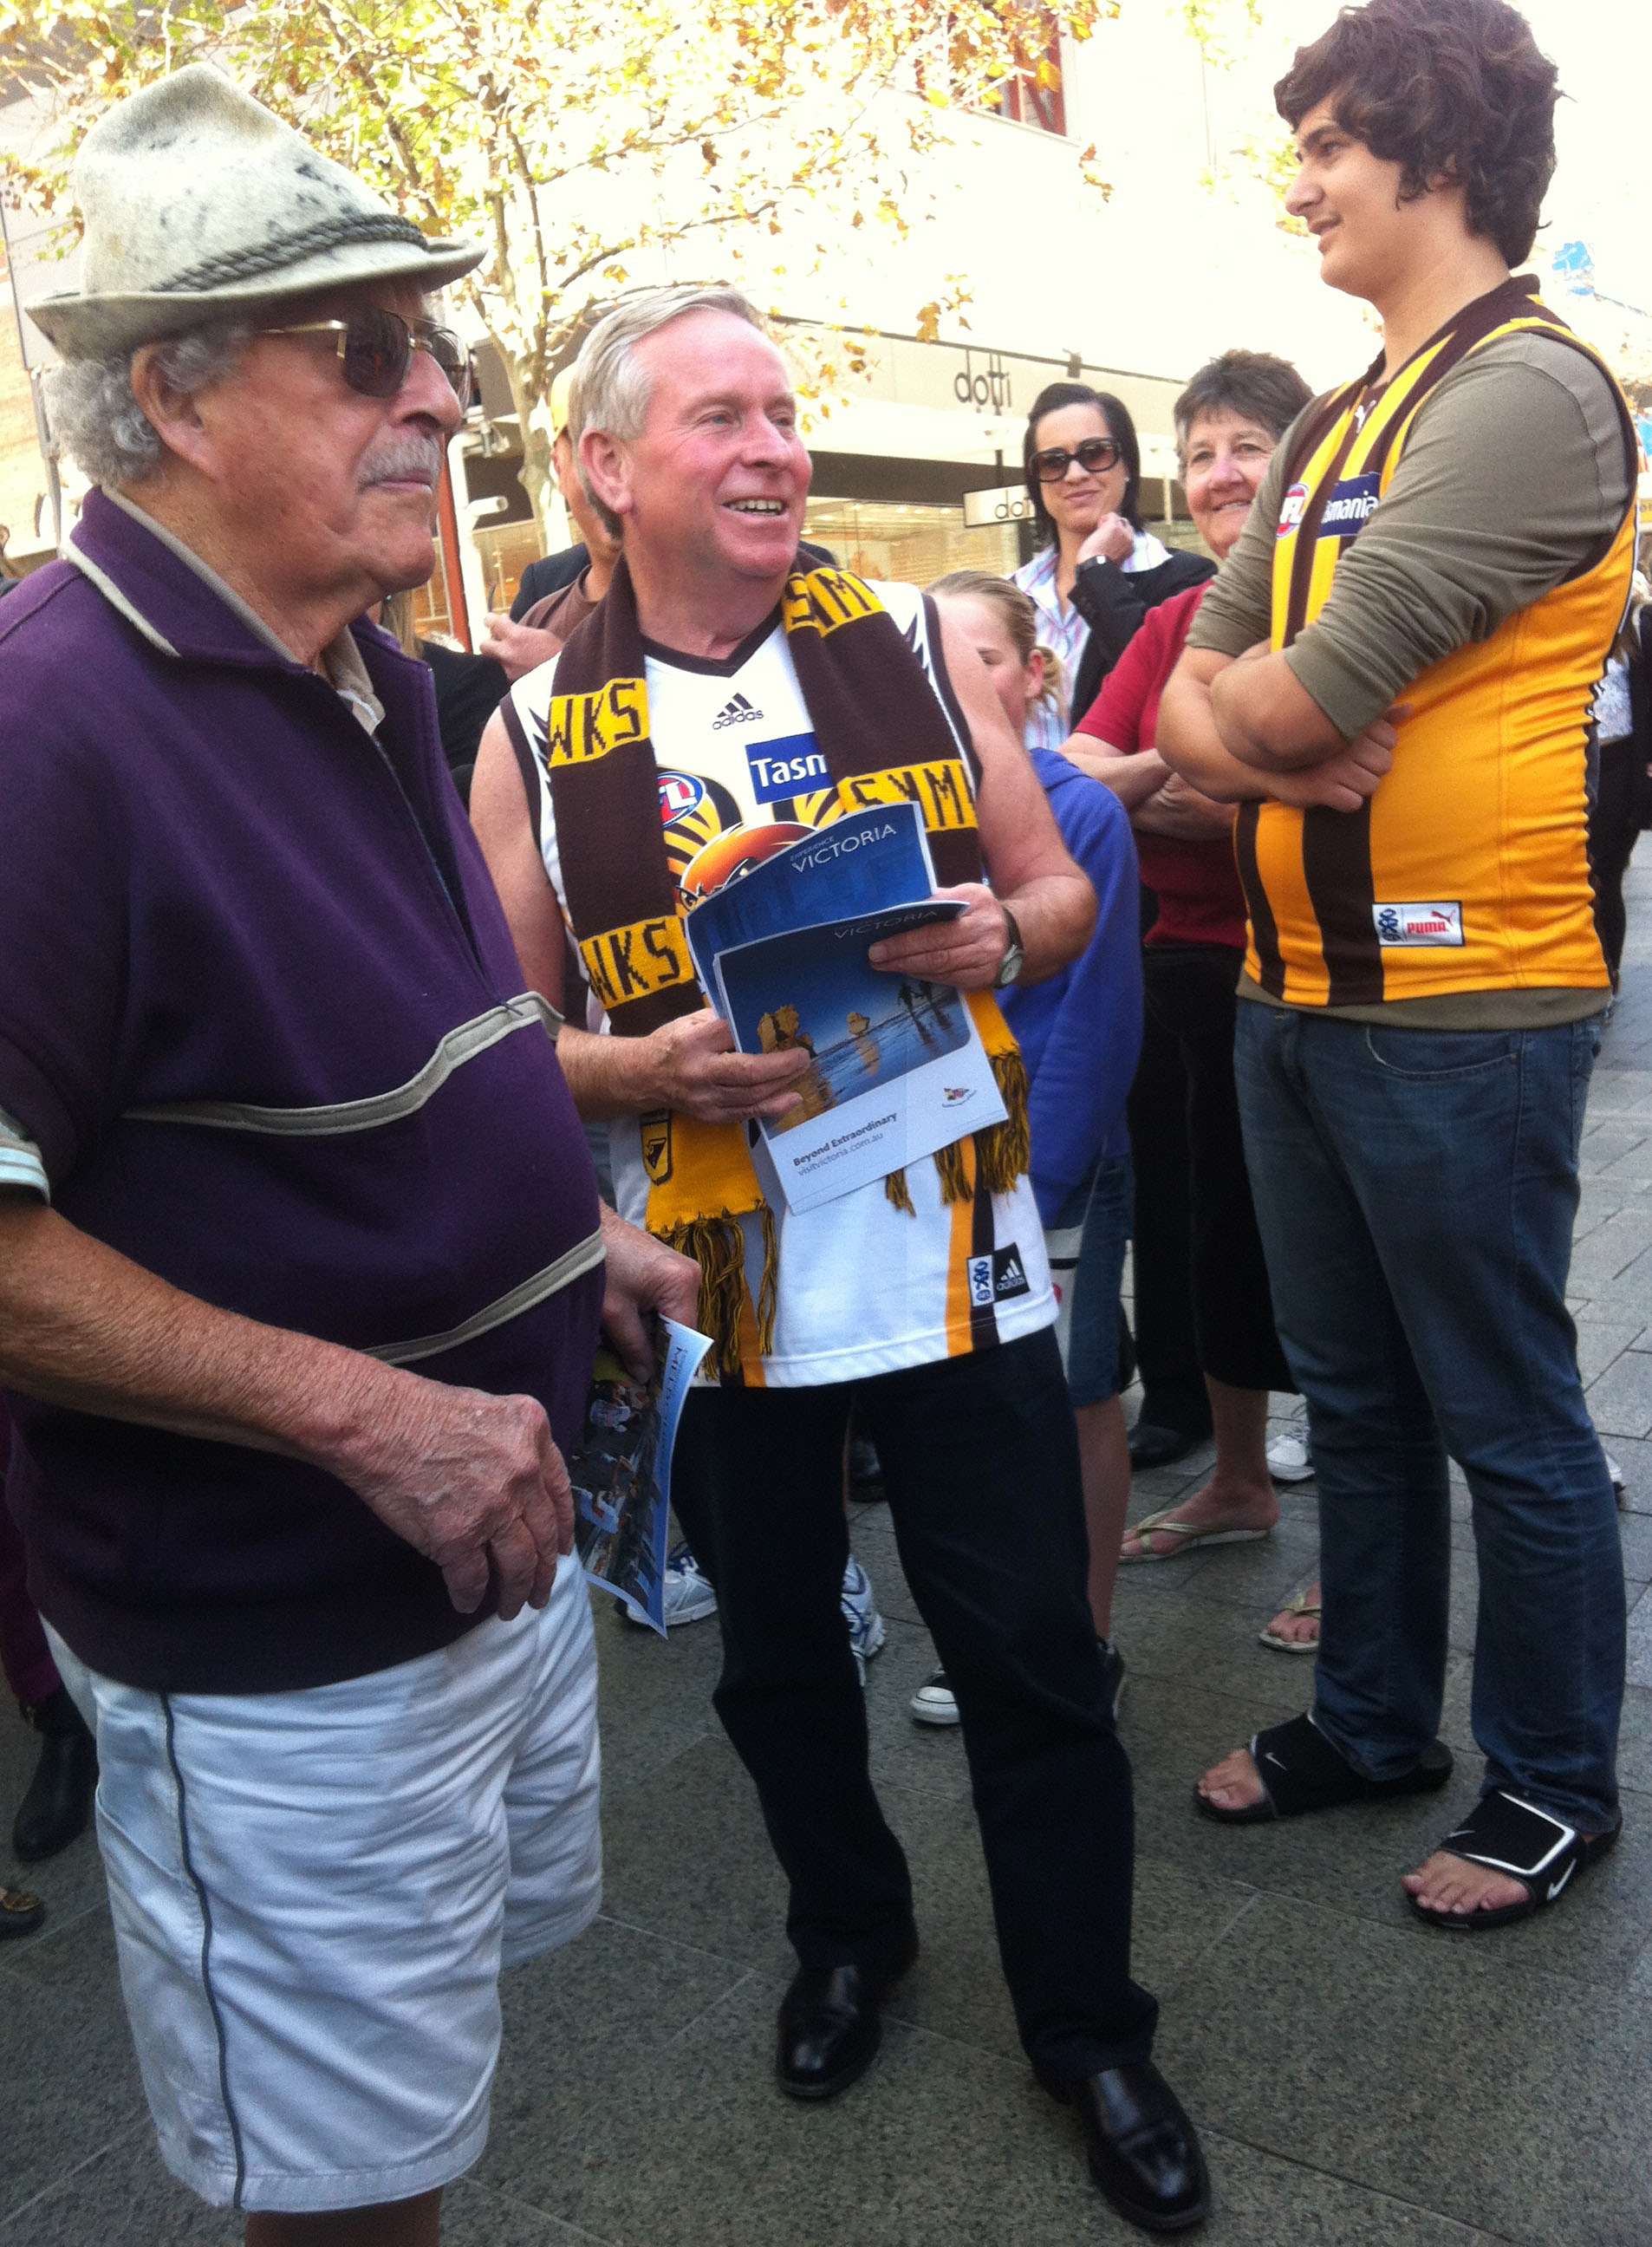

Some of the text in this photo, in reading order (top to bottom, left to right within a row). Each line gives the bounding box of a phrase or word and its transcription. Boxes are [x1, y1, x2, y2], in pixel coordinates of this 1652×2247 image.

[712, 710, 764, 730] adidas
[791, 824, 897, 873] VICTORIA
[834, 910, 937, 939] VICTORIA
[793, 1113, 897, 1166] Beyond Extraordinary
